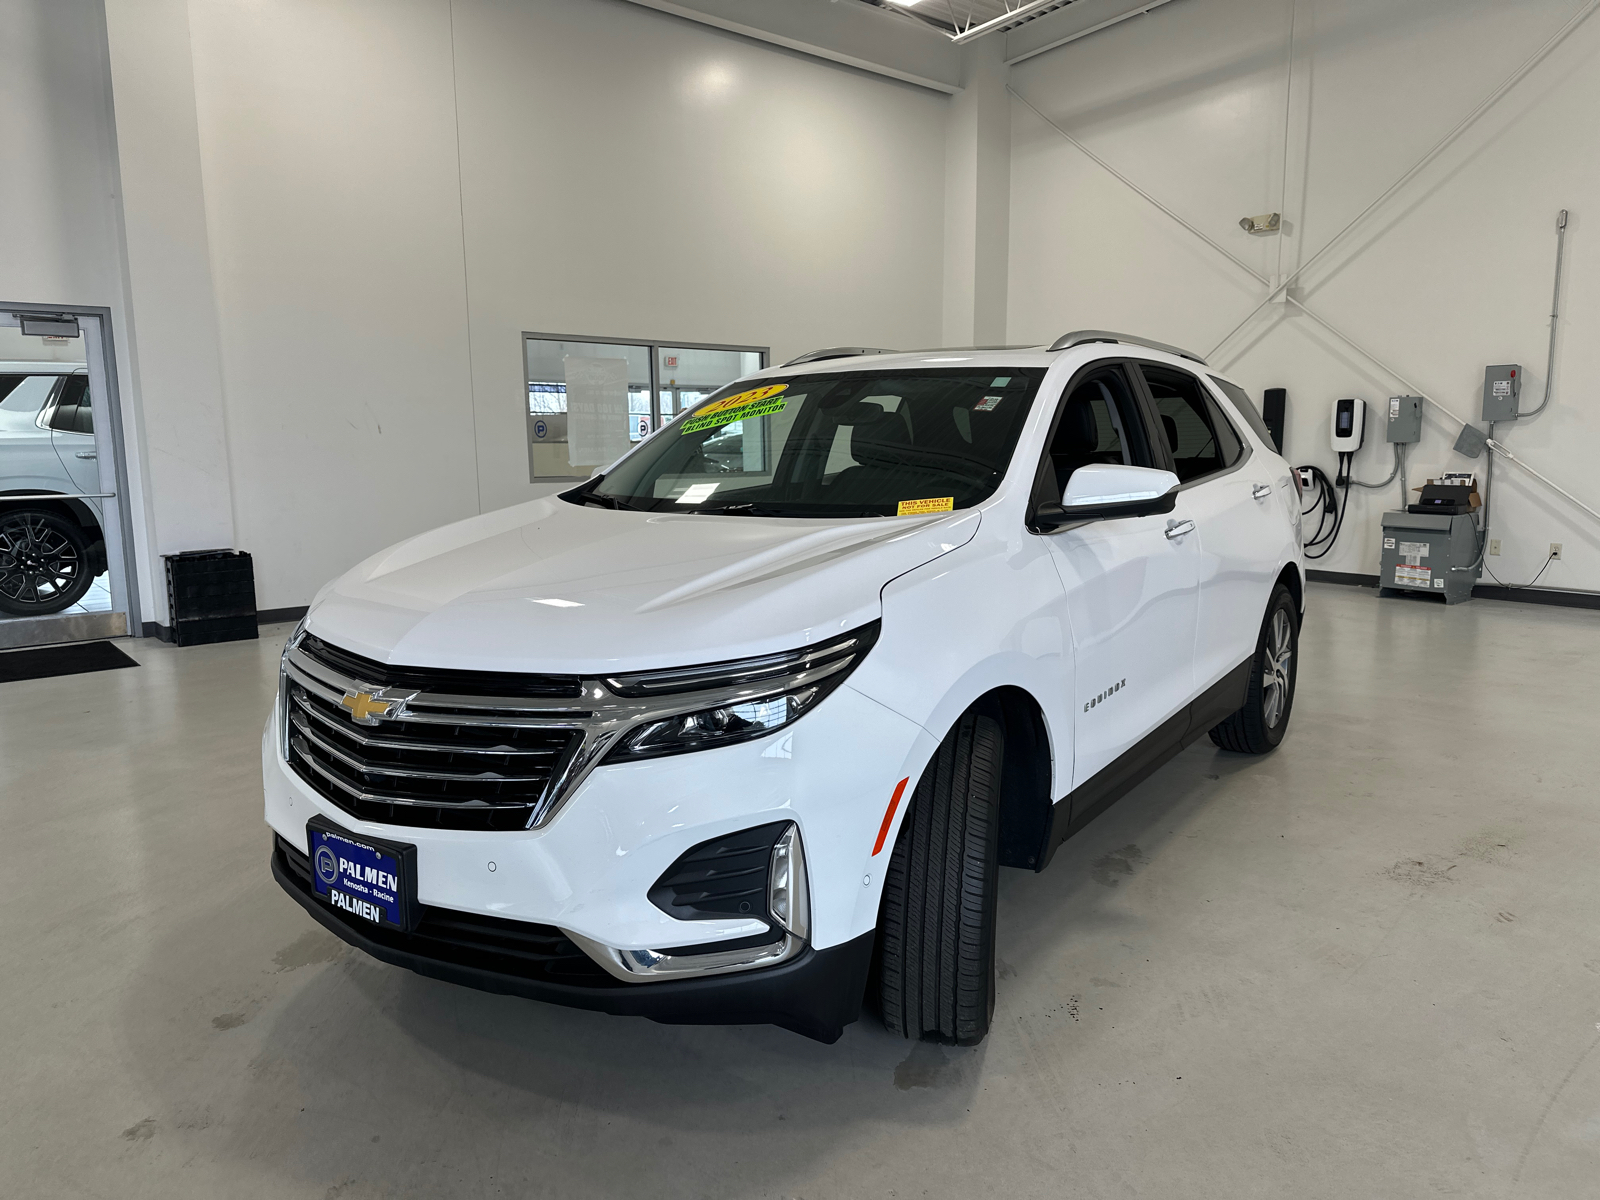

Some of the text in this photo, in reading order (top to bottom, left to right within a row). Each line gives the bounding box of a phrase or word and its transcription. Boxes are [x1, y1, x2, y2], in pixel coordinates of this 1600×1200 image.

[683, 396, 780, 428] PUSH BUTTON START
[705, 387, 774, 413] 2023
[684, 403, 786, 433] BLIND SPOT MONITOR
[1083, 678, 1127, 713] EQUINOX
[325, 831, 375, 852] palmen.com
[339, 857, 398, 892] PALMEN
[343, 877, 369, 894] Kenosha
[373, 888, 394, 903] Racine
[331, 889, 380, 923] PALMEN
